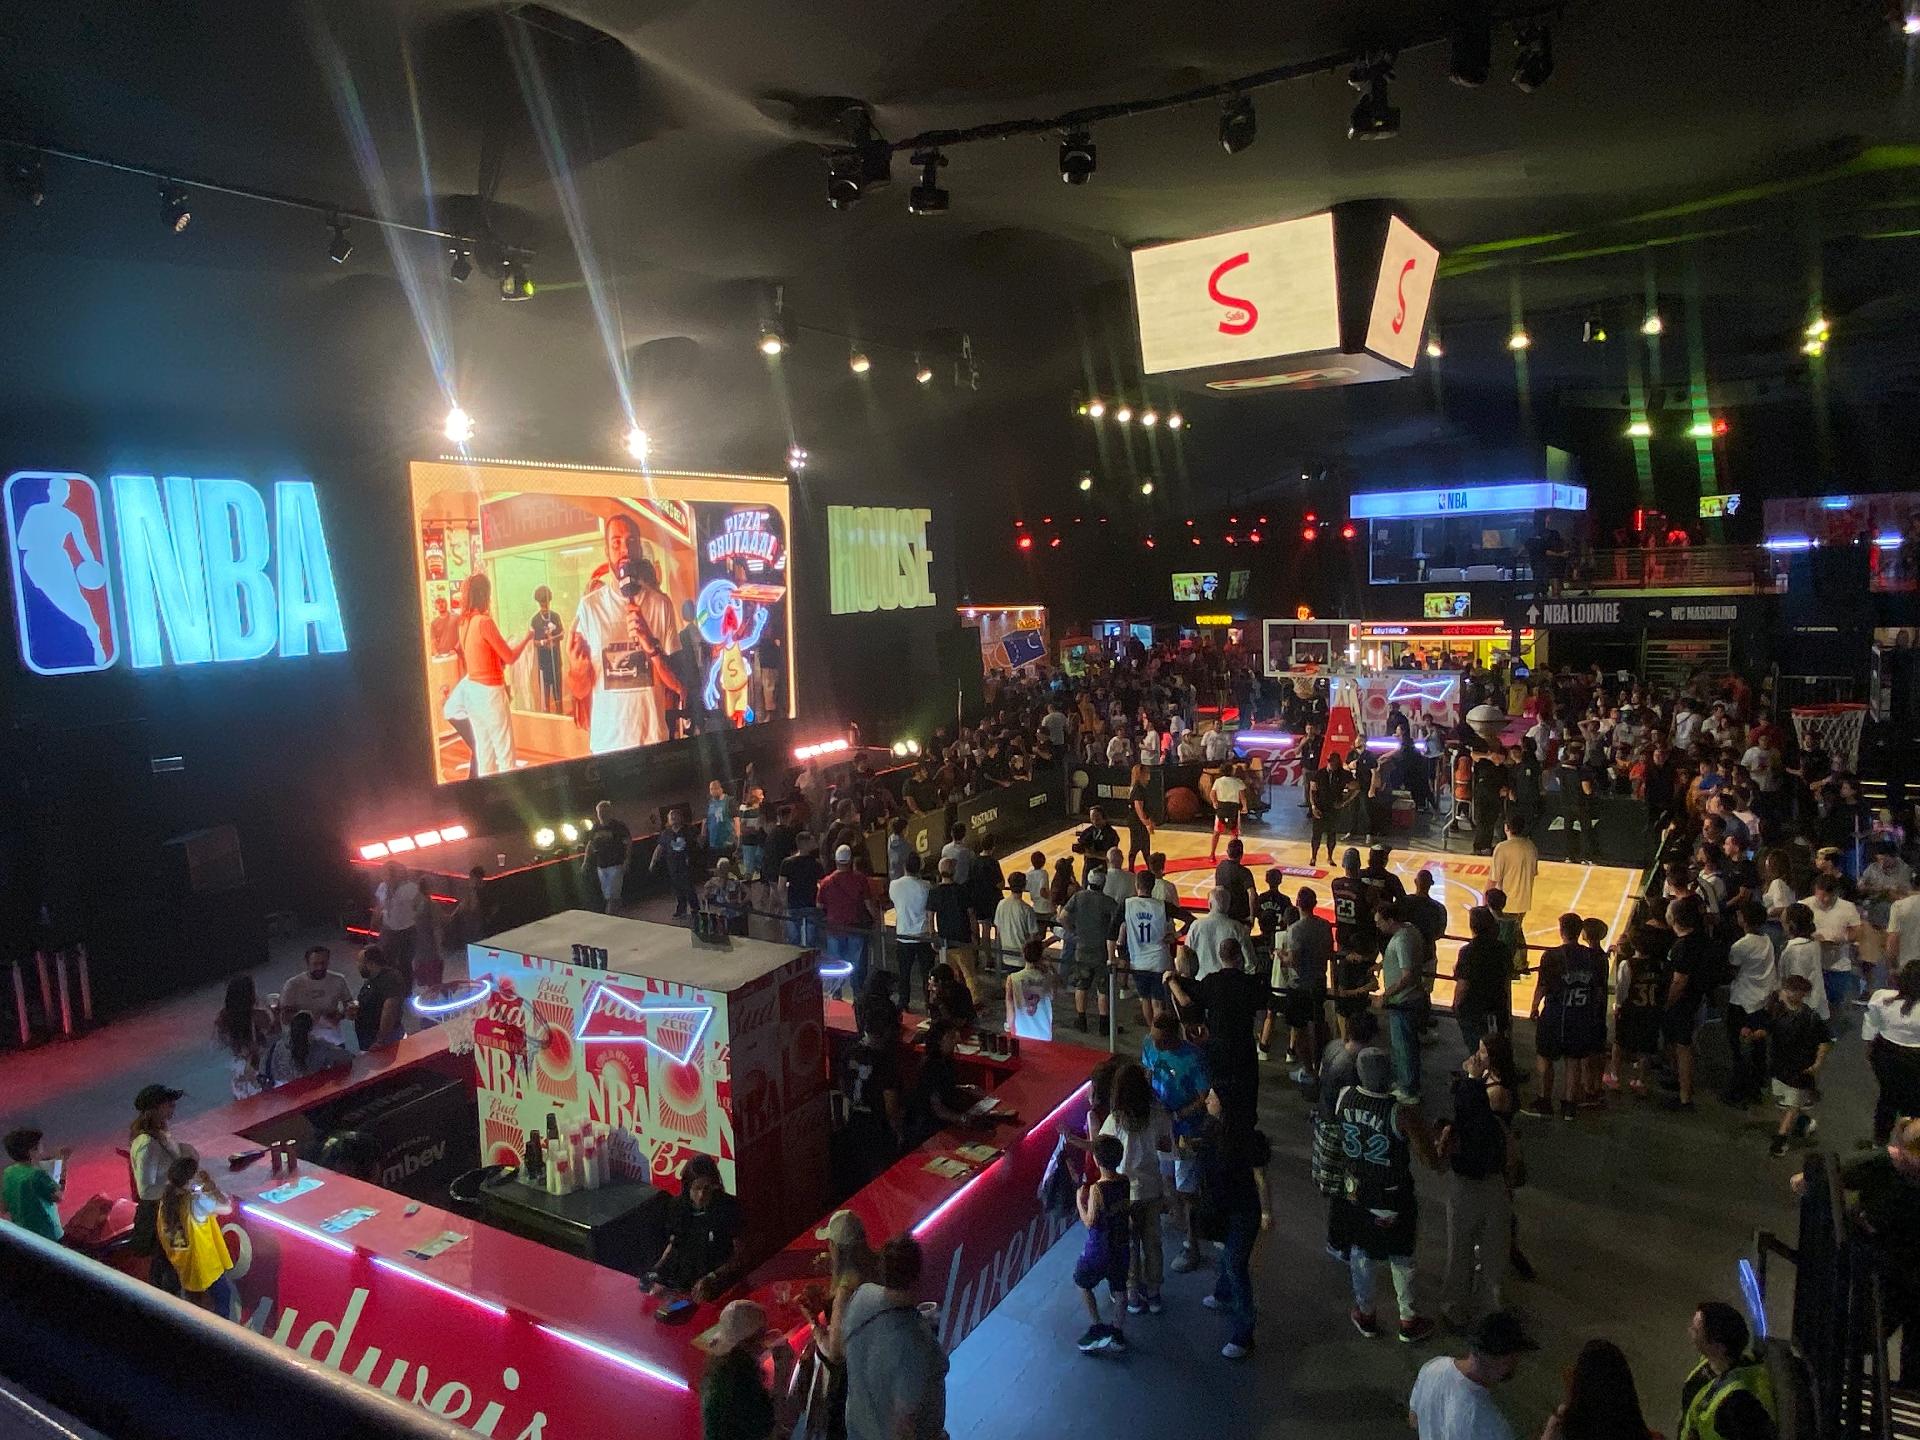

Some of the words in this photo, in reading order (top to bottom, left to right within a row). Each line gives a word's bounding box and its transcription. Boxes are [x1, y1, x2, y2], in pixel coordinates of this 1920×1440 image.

[1208, 252, 1259, 336] S
[1447, 491, 1468, 510] NBA
[724, 510, 765, 533] PIZZA
[110, 475, 348, 669] NBA
[827, 505, 937, 615] HOUSE
[1543, 604, 1569, 625] NBA
[1571, 602, 1622, 624] LOUNGE
[915, 829, 929, 854] G
[1336, 898, 1356, 918] 23
[1138, 922, 1151, 943] 11
[537, 976, 568, 995] Bud
[537, 992, 570, 1007] ZERO
[473, 1000, 526, 1028] ud
[474, 1043, 533, 1101] NBA
[489, 1095, 518, 1116] Bud
[584, 1070, 652, 1140] NBA
[1342, 1122, 1391, 1168] 32
[382, 1138, 447, 1188] mbev
[652, 1138, 688, 1180] Bu
